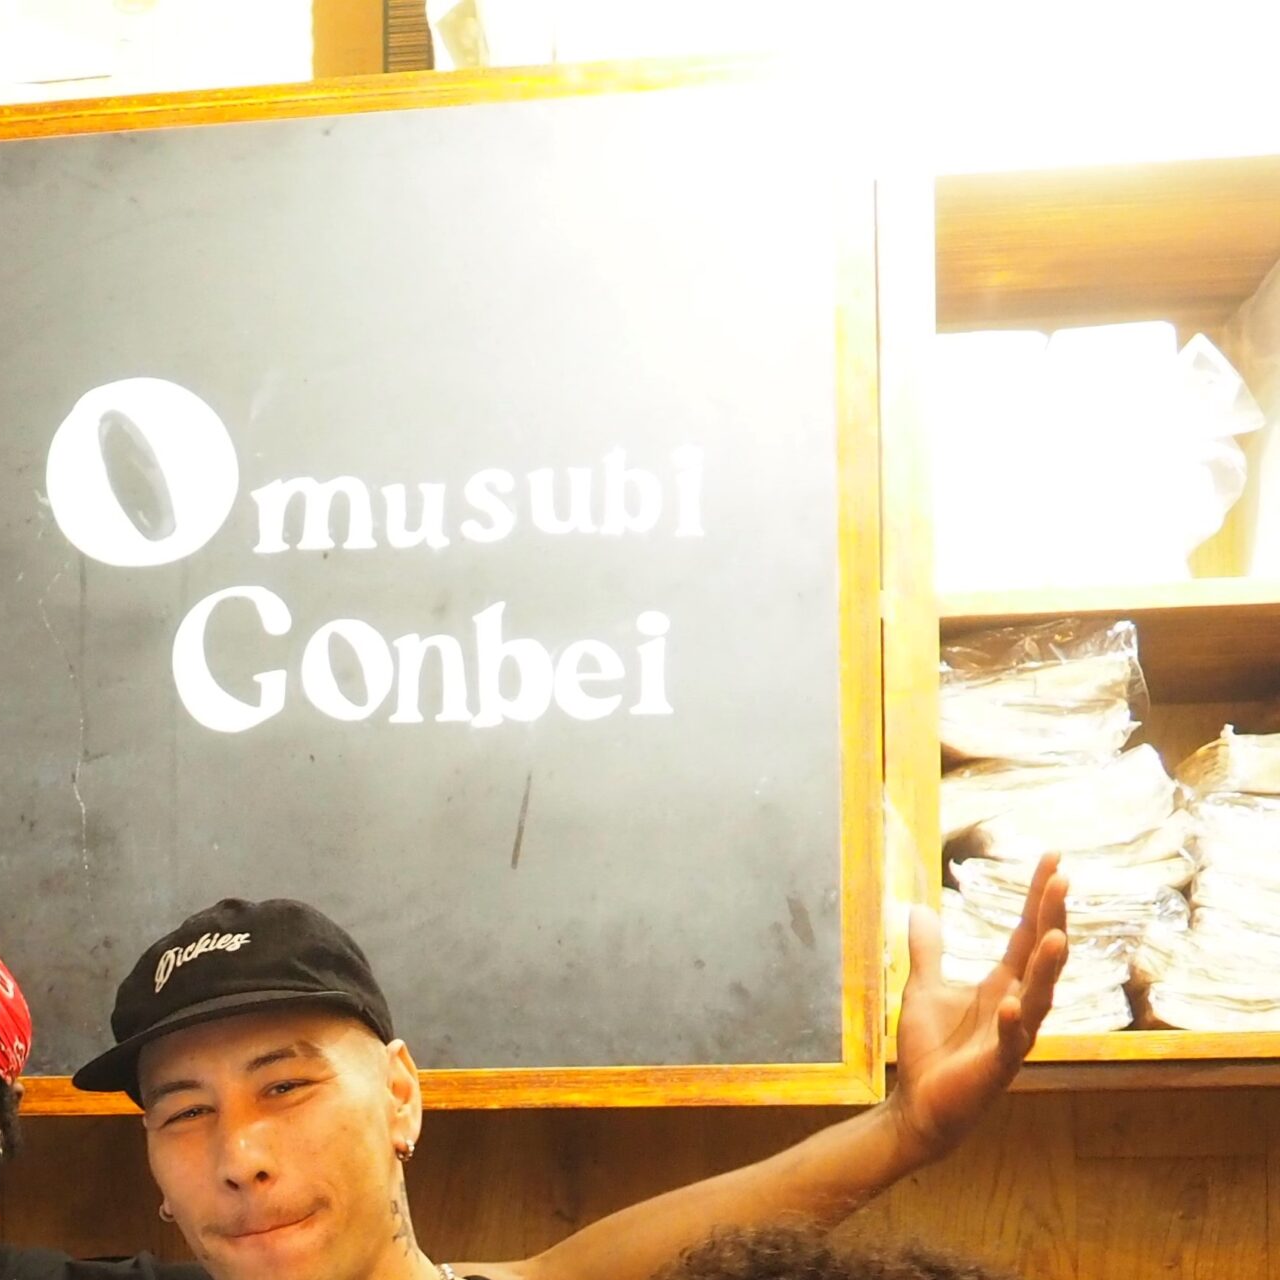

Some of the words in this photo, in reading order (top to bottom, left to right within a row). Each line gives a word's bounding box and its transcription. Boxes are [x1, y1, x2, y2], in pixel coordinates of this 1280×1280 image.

[45, 376, 706, 567] Omusubi
[171, 585, 675, 733] Gonbei
[154, 932, 251, 993] Dickies
